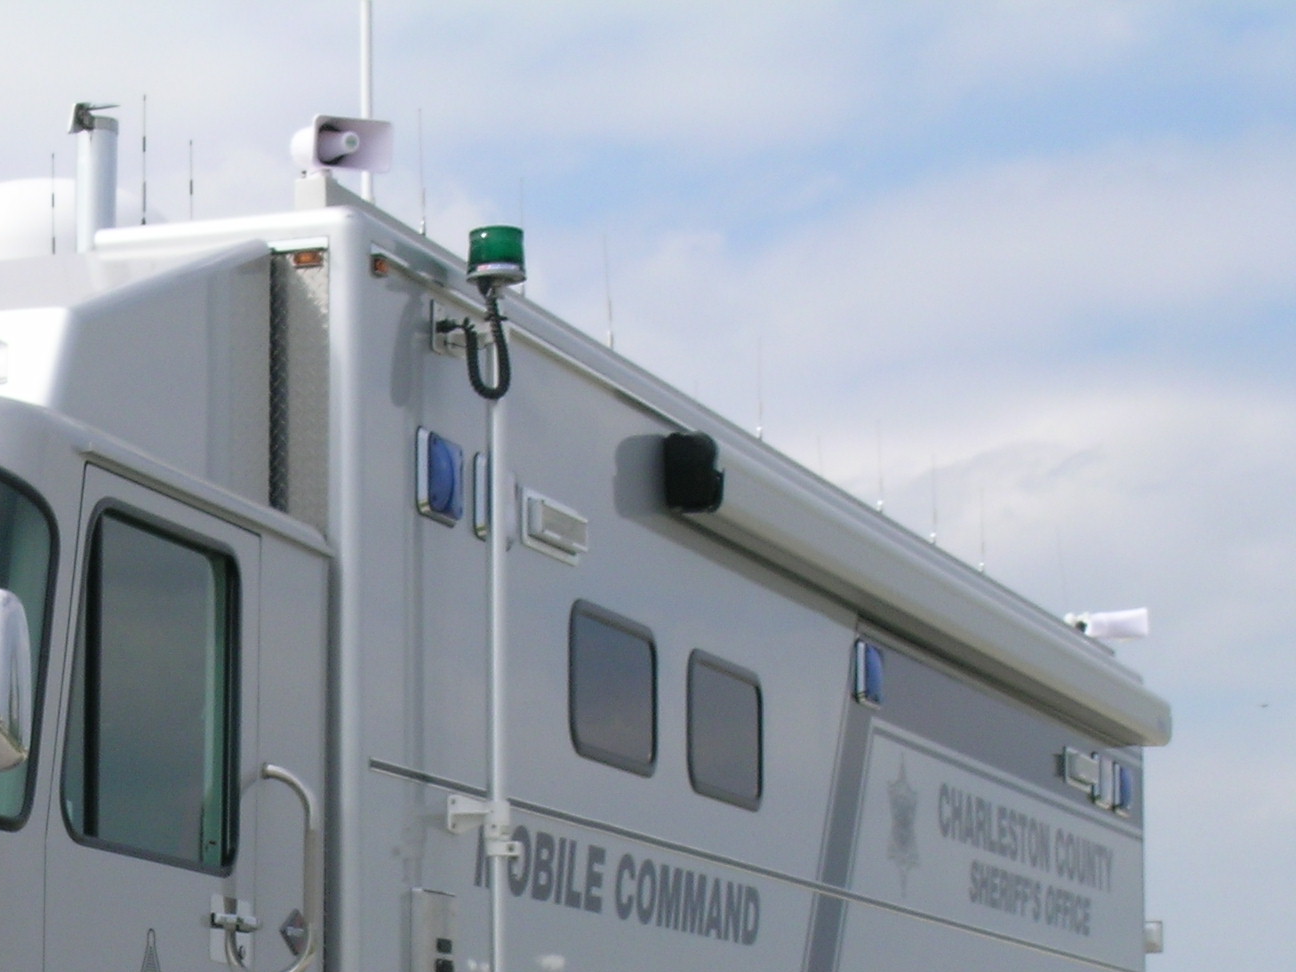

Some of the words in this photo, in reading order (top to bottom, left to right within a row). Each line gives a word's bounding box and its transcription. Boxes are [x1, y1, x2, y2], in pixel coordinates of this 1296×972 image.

[938, 782, 1051, 873] CHARLESTON
[1055, 827, 1114, 893] COUNTY
[614, 853, 761, 946] COMMAND
[969, 859, 1042, 922] SHERIFF'S
[1045, 884, 1092, 937] OFFICE
